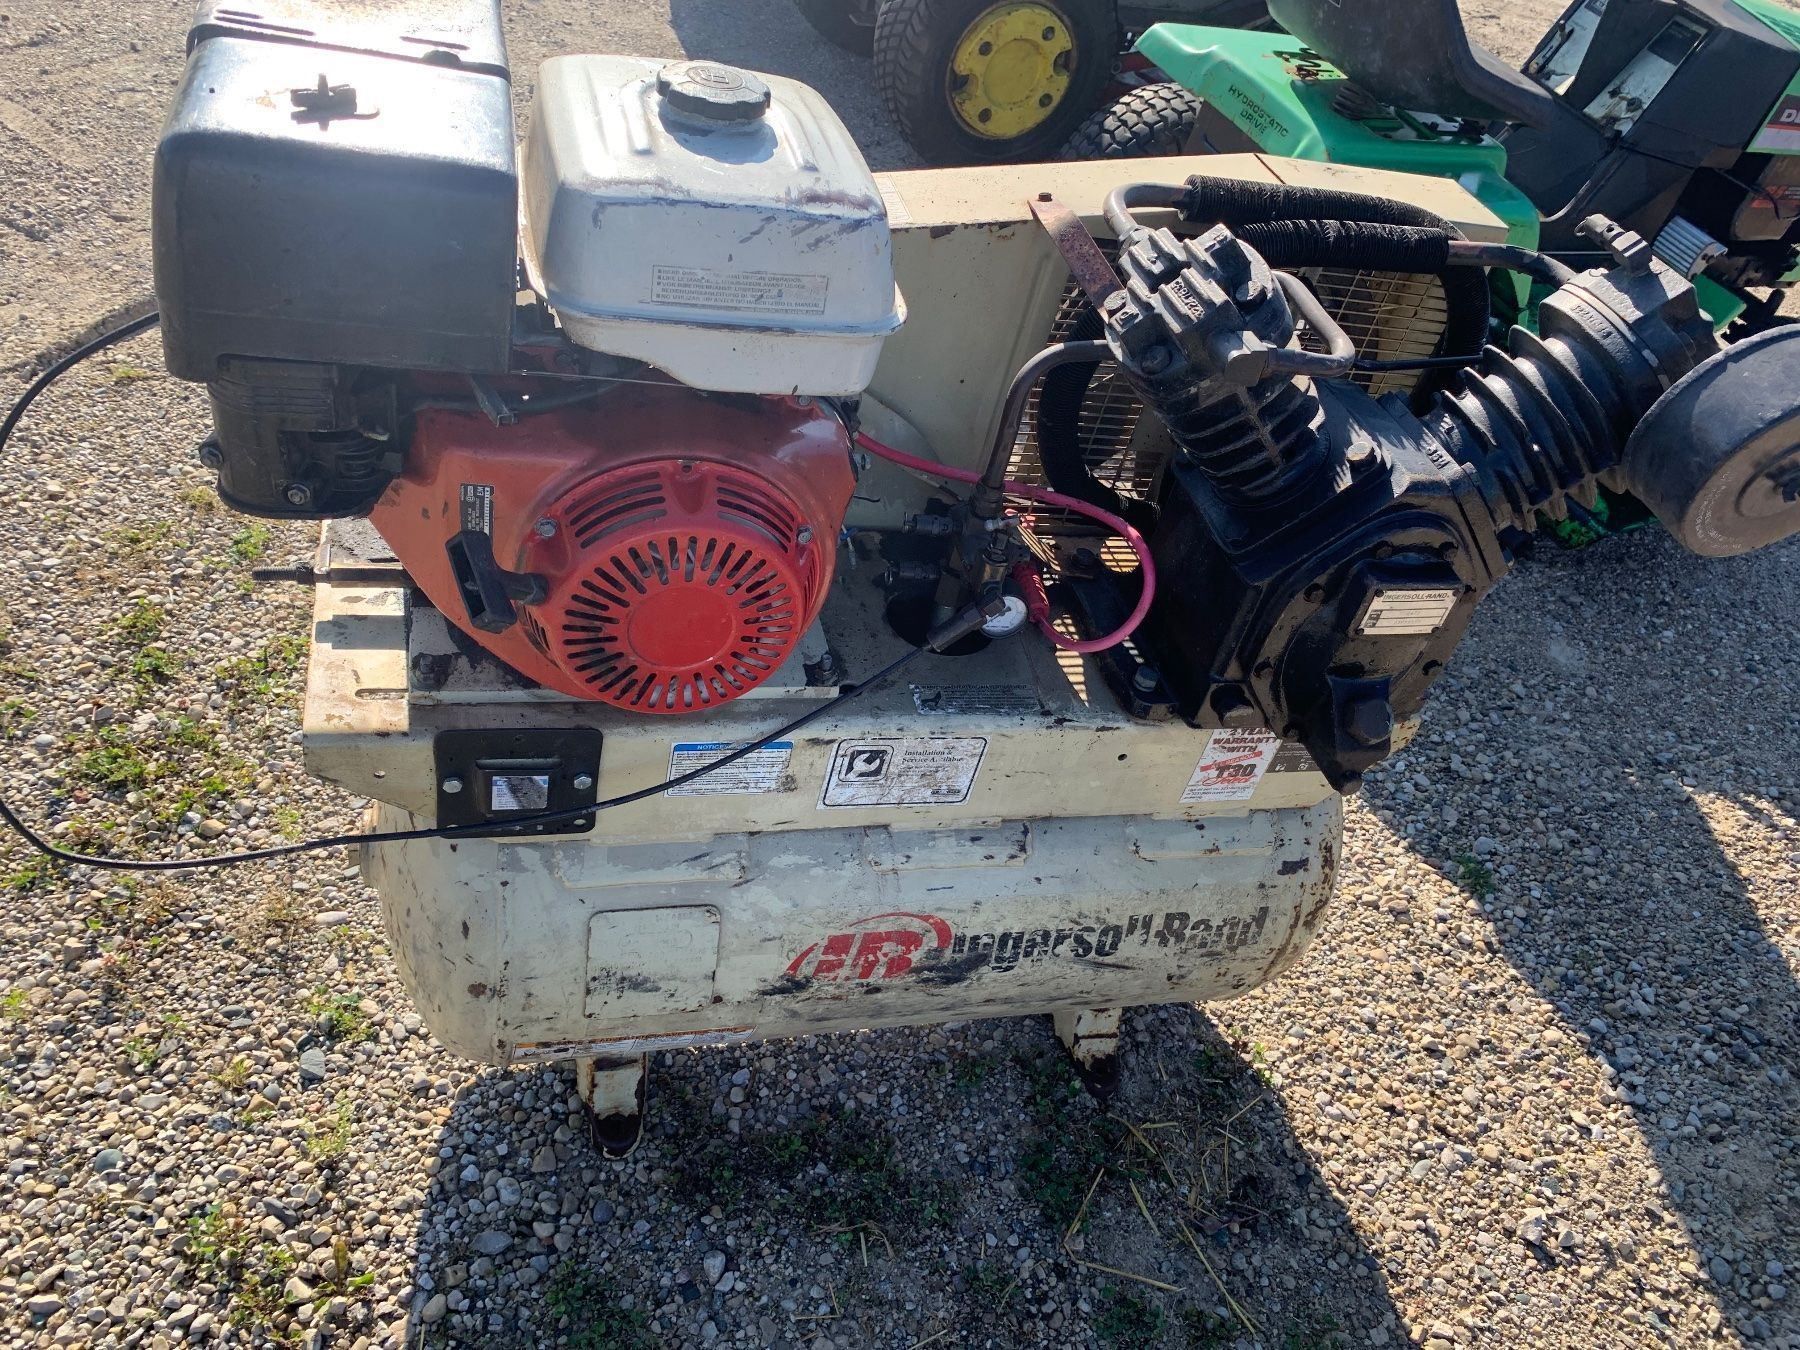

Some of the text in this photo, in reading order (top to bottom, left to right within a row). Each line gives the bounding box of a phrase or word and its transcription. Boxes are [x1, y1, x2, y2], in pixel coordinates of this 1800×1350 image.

[1228, 85, 1289, 137] HYDROSTATIC
[1383, 592, 1447, 600] INGERSOLL-RAND
[1227, 745, 1258, 753] WITH
[1215, 763, 1257, 778] T30
